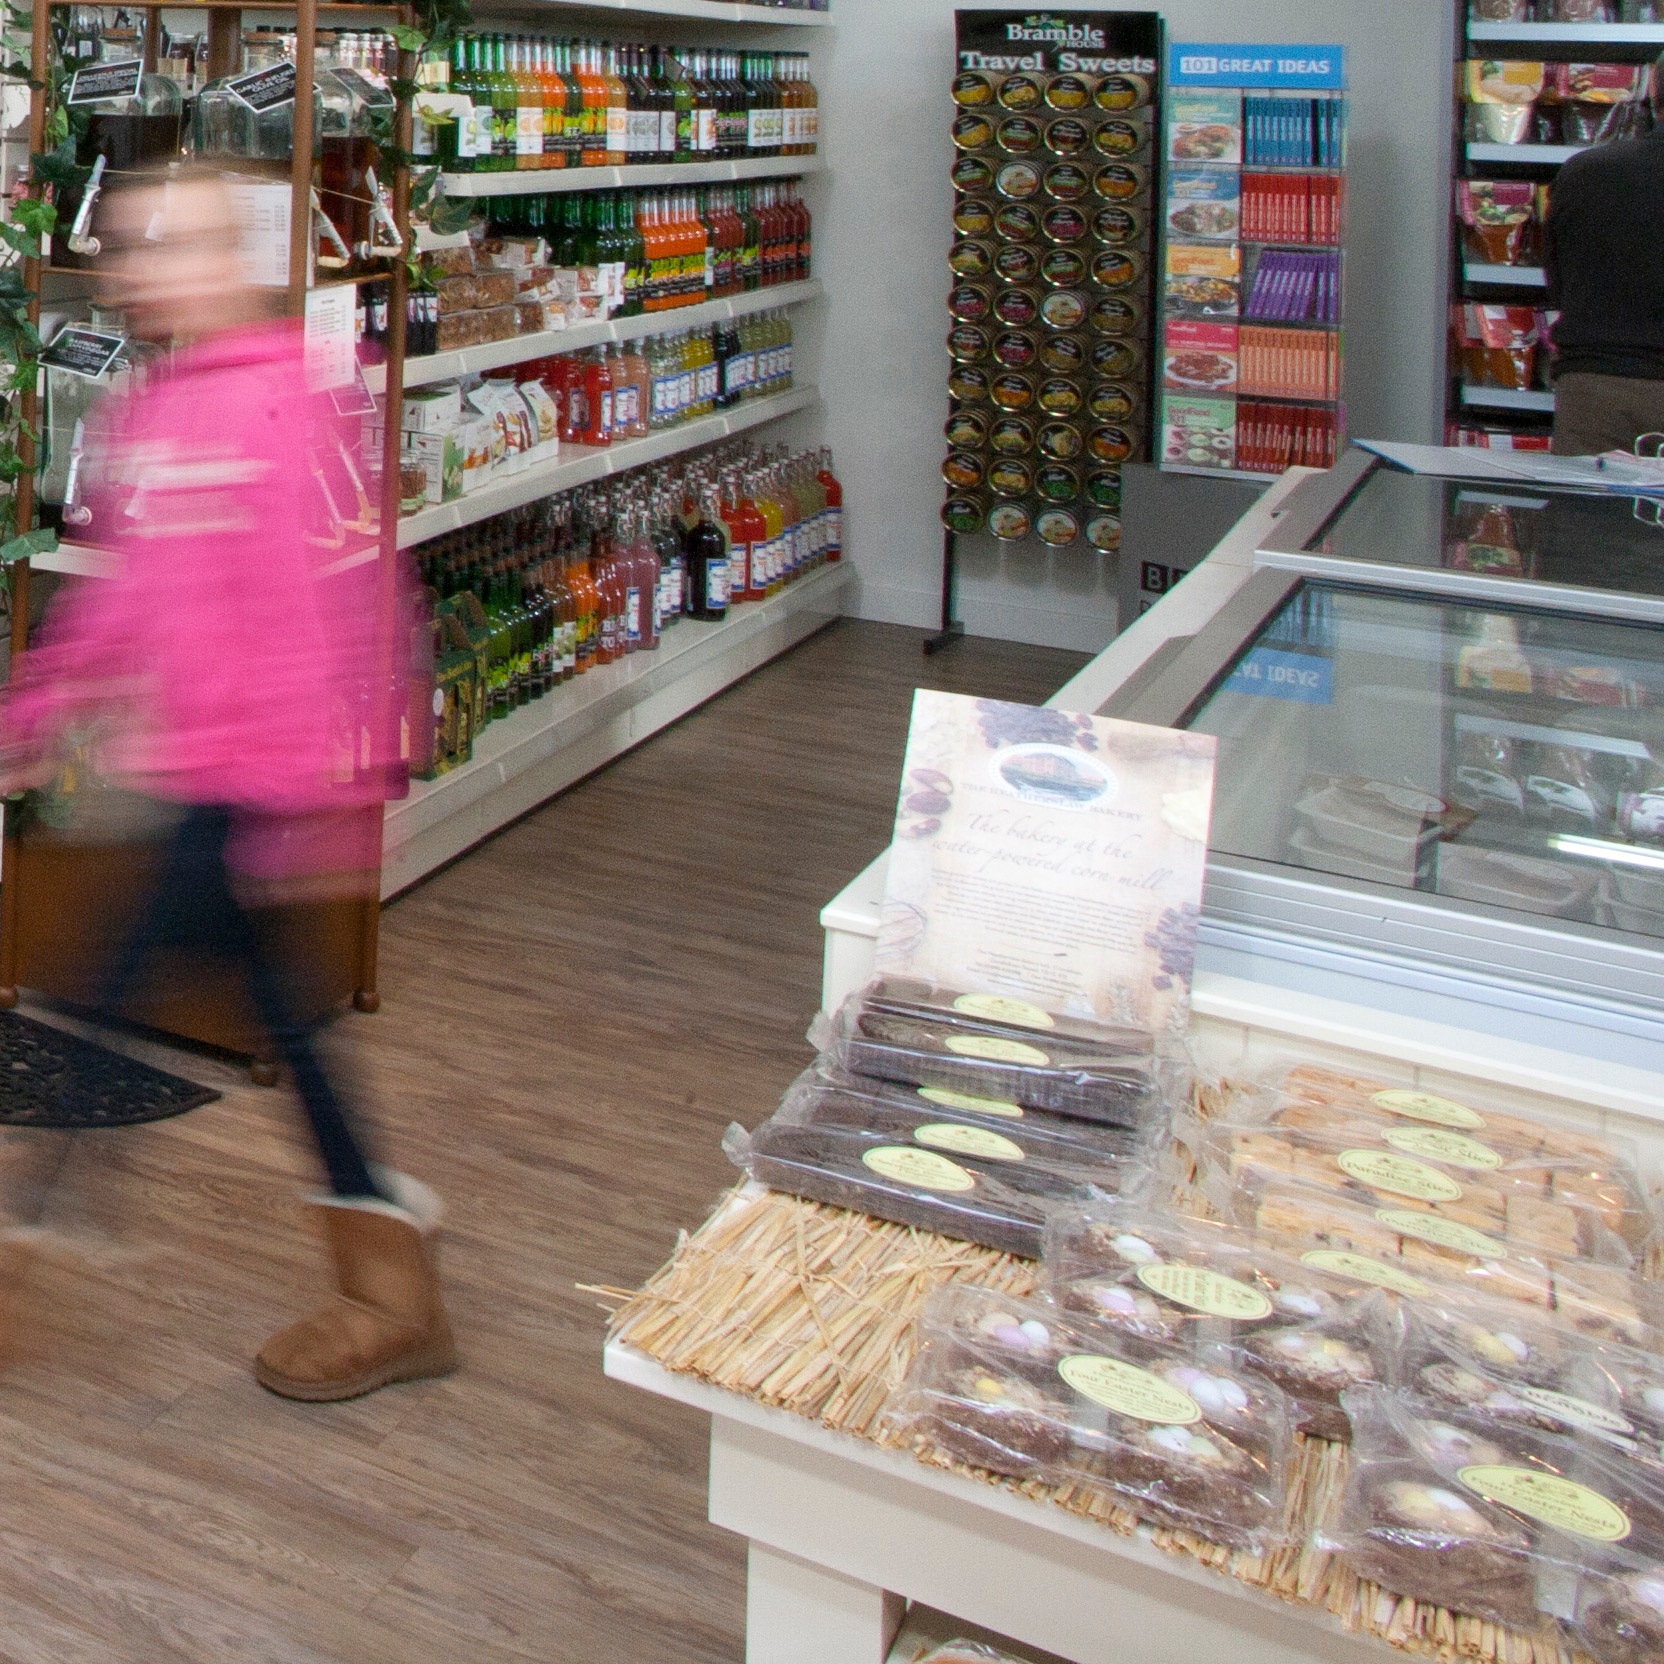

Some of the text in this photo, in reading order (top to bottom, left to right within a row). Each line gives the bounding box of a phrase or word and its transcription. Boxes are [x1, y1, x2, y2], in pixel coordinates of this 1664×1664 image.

[1006, 24, 1105, 41] Bramble
[1066, 39, 1106, 49] HOUSE
[960, 51, 1156, 74] Travel Sweets
[1184, 58, 1331, 74] 101 GREAT IDEAS
[1090, 804, 1143, 821] BAKERY
[969, 808, 1143, 860] The bakery at the
[1072, 865, 1110, 882] corn
[1118, 867, 1174, 891] mill
[1347, 1161, 1453, 1195] Paradise Slice
[1071, 1368, 1190, 1411] Four Easter Nests
[1511, 1490, 1565, 1513] Easter
[1571, 1509, 1617, 1529] Nests
